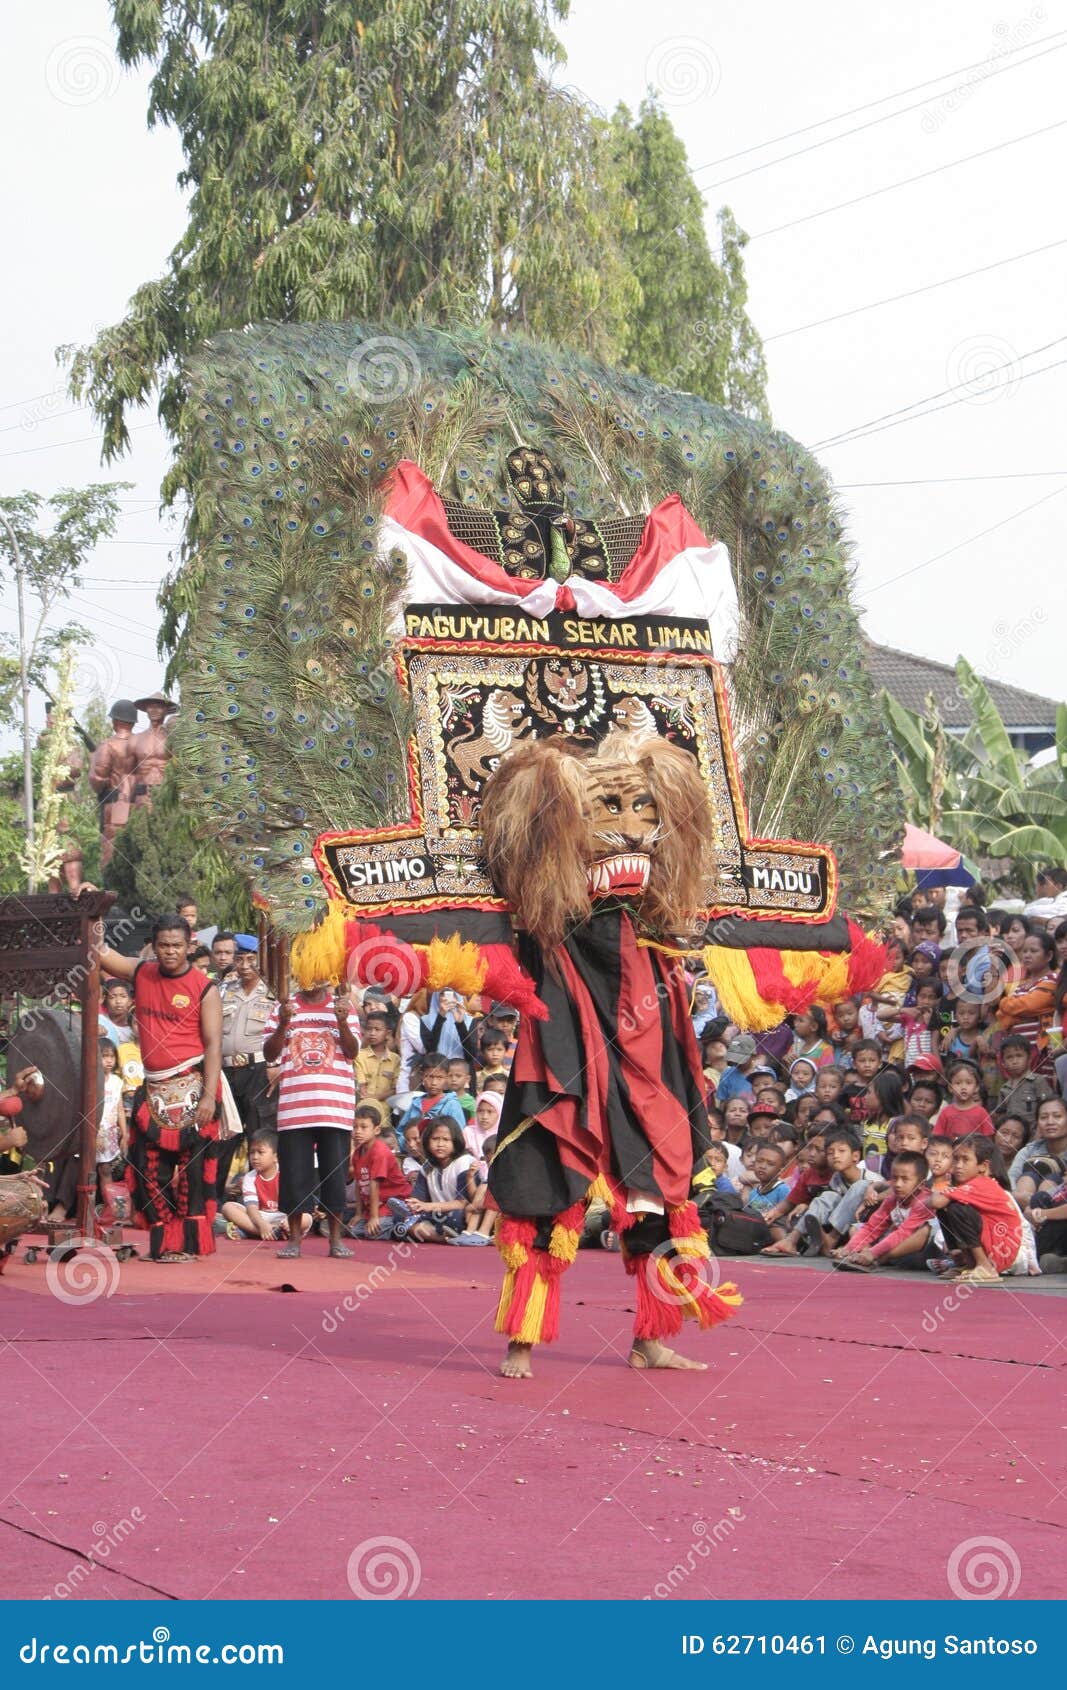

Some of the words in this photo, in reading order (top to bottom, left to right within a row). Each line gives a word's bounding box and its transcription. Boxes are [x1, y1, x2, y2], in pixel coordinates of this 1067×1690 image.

[406, 614, 550, 642] PAGUYUBAN
[563, 619, 638, 647] SEKAR
[646, 625, 711, 650] LIMAN
[349, 858, 425, 886] SHIMO
[752, 867, 812, 894] MADU
